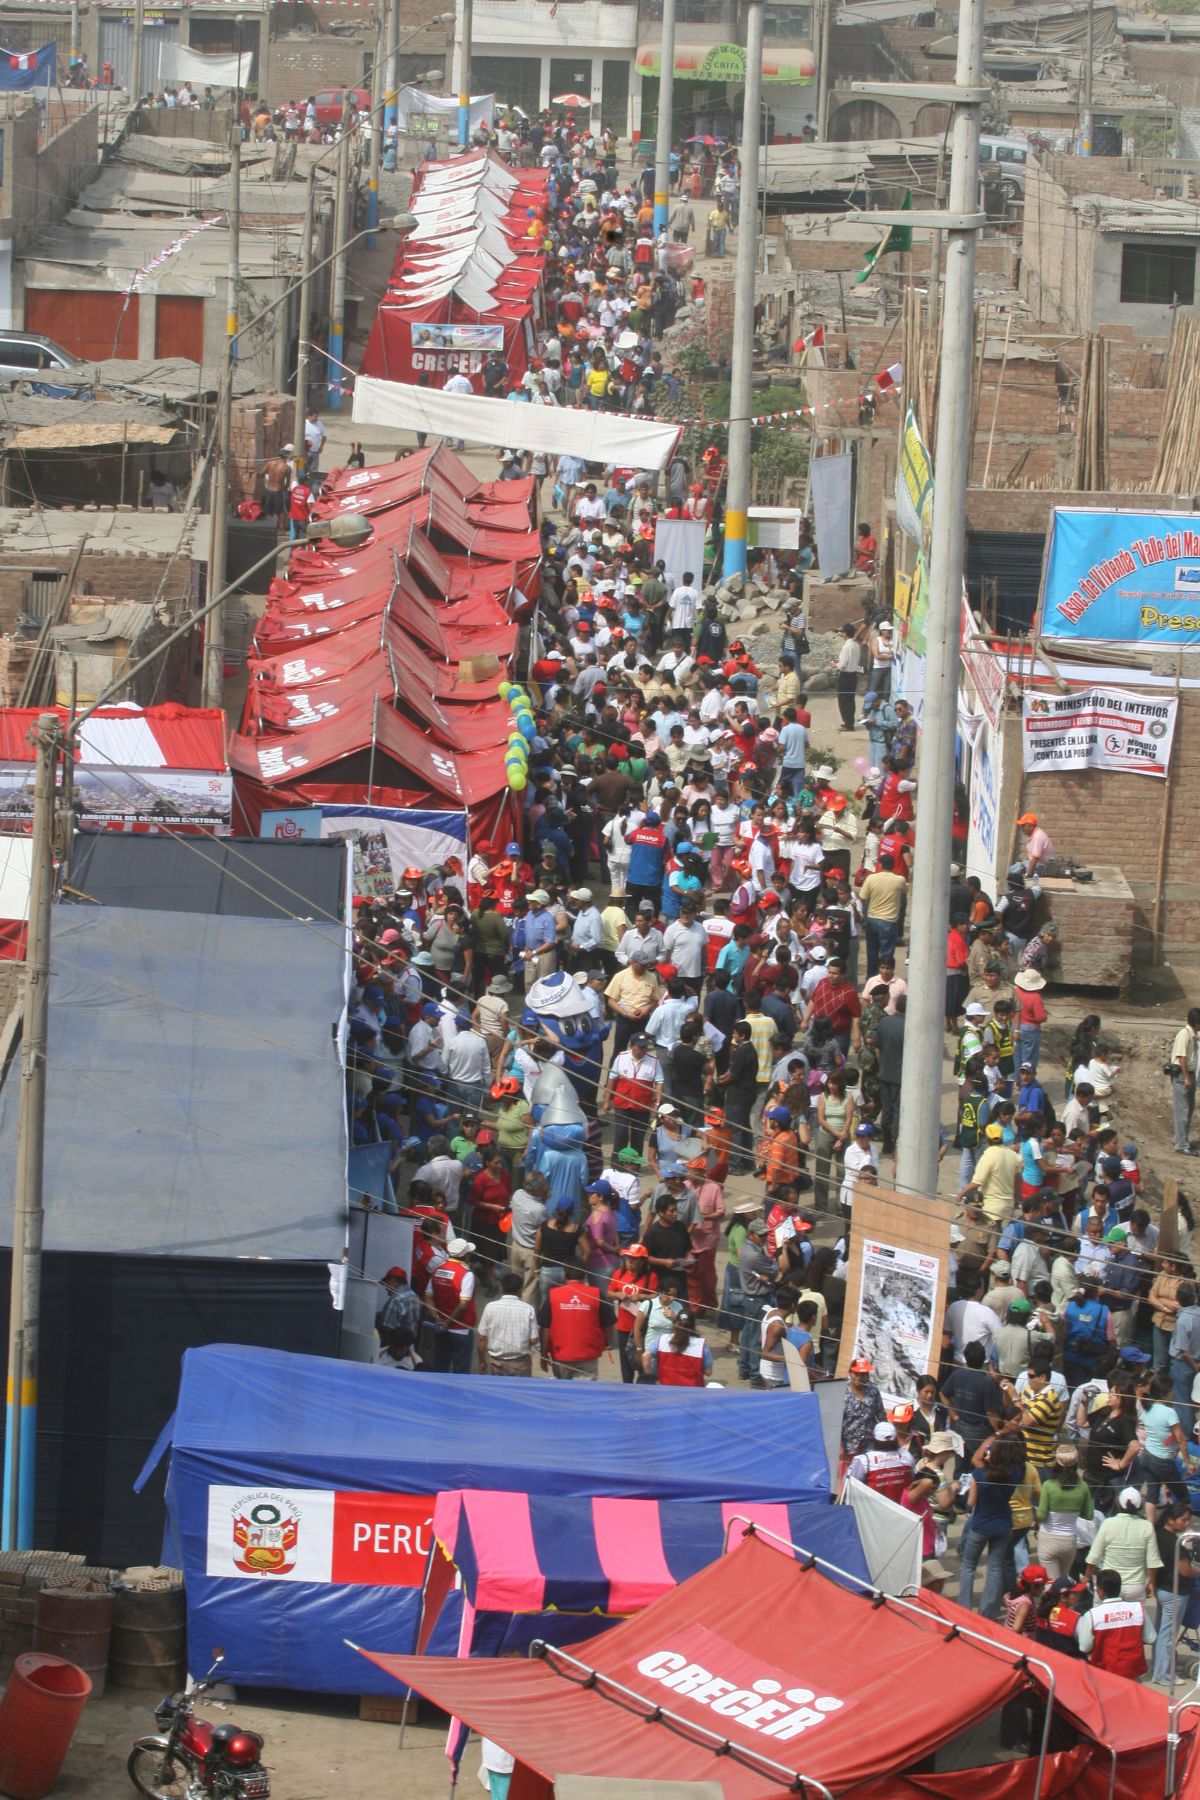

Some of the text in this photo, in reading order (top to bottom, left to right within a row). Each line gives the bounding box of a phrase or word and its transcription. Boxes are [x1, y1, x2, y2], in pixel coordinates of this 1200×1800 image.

[1165, 532, 1182, 559] del
[1088, 549, 1137, 591] Vivienda
[1079, 578, 1102, 600] de
[1057, 591, 1093, 624] Asoc.
[1107, 698, 1123, 711] DEL
[1124, 701, 1169, 719] INTERIOR
[1030, 736, 1067, 749] PRESENTES
[1067, 736, 1076, 746] EN
[1077, 735, 1085, 745] LA
[1064, 749, 1073, 759] LA
[82, 813, 123, 821] AMBIENTAL
[540, 985, 568, 1005] sedapal
[270, 1492, 284, 1503] DEL
[353, 1518, 434, 1556] PERÚ
[637, 1650, 826, 1741] CRECER
